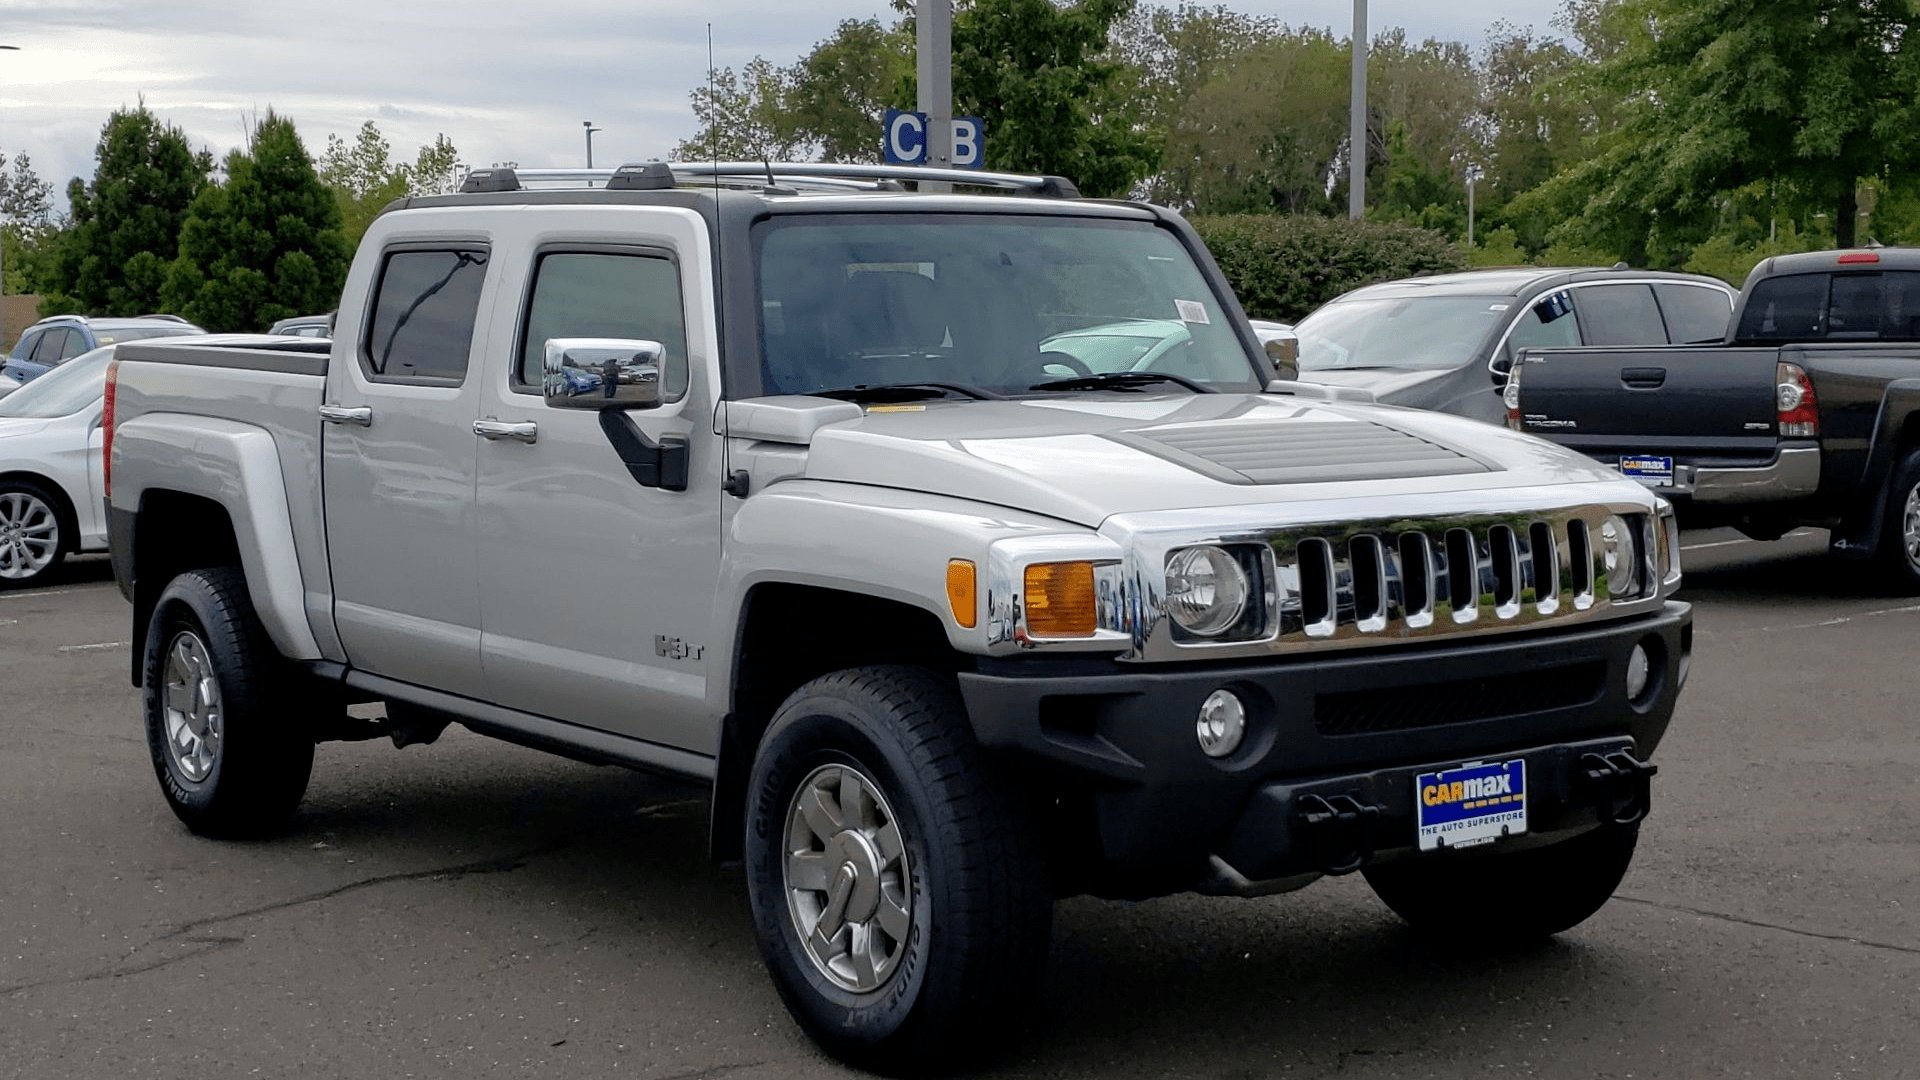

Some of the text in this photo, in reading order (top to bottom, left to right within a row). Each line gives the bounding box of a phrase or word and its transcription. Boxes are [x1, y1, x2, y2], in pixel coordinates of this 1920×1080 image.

[890, 113, 922, 161] C
[951, 120, 977, 164] B
[1423, 773, 1512, 806] CARmax
[1421, 811, 1524, 836] THE AUTO SUPERSTORE
